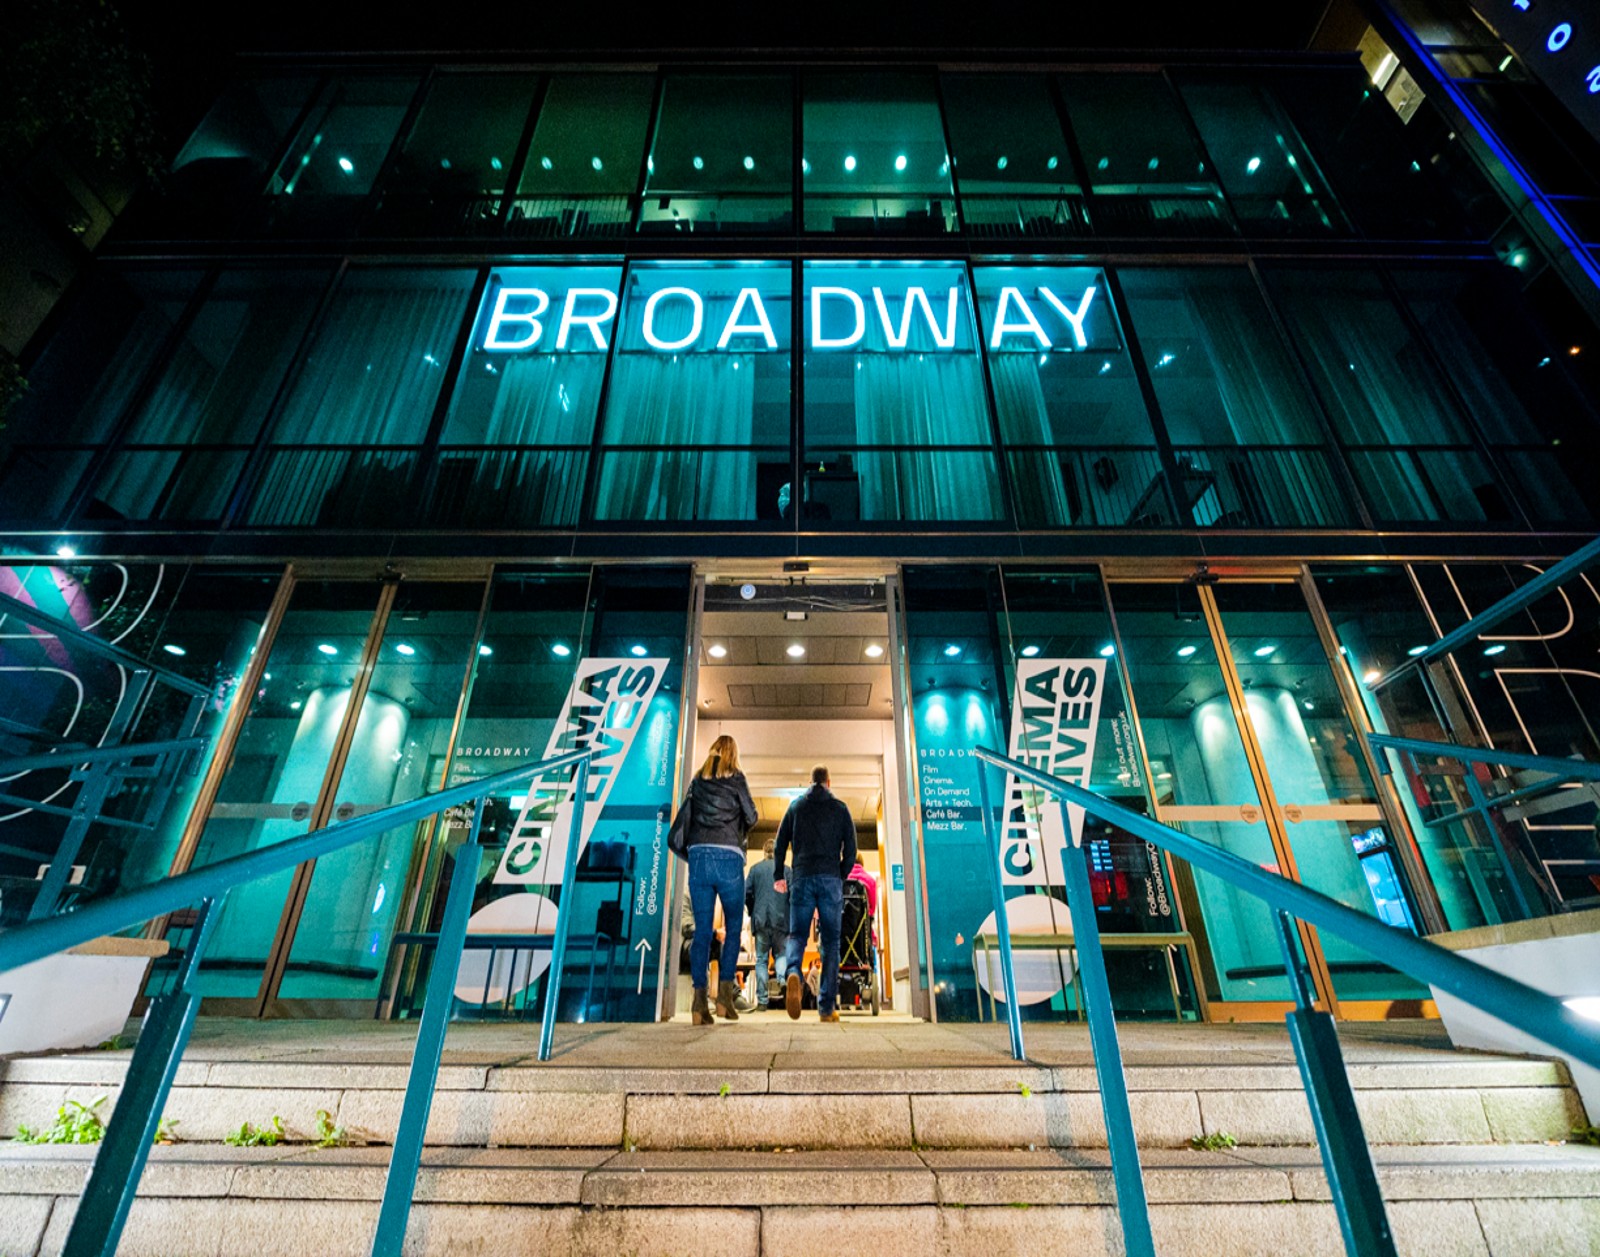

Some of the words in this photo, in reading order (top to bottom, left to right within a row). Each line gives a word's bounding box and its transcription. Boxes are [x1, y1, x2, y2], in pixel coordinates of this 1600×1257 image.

[483, 286, 1097, 349] BROADWAY
[456, 747, 531, 757] BROADWAY
[920, 748, 977, 758] BROADW
[924, 787, 936, 796] On
[937, 787, 970, 796] Demand
[925, 798, 943, 807] Arts
[926, 821, 949, 830] Mezz
[646, 811, 664, 915] @BroadwayCinema
